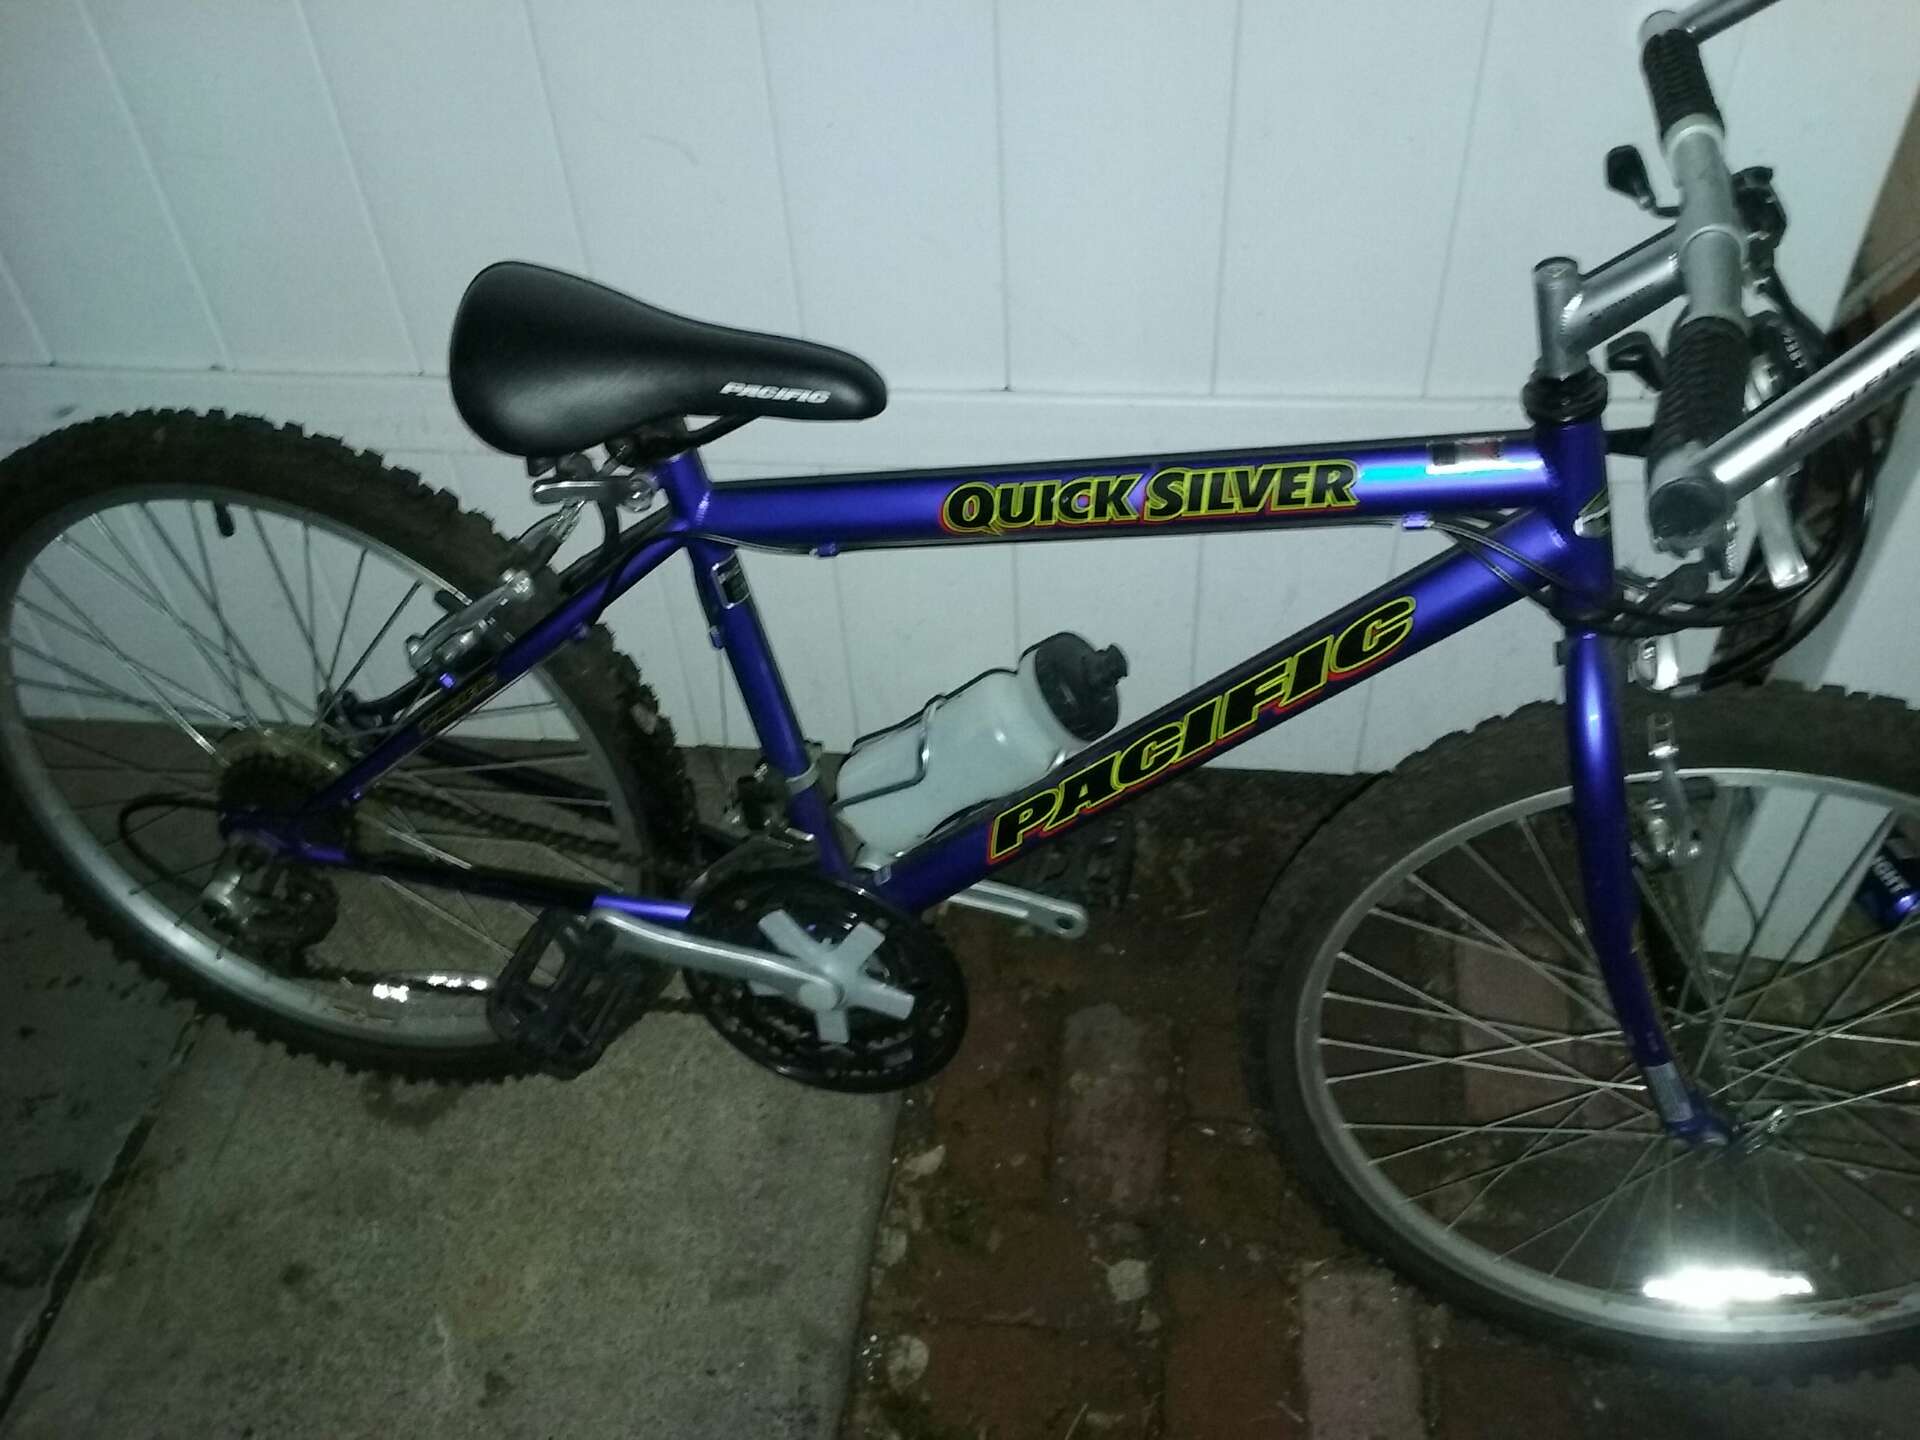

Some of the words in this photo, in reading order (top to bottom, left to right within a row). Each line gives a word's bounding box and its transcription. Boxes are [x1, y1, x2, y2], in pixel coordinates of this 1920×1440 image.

[720, 381, 832, 404] PACIFIC
[941, 474, 1143, 535] QUICK
[1142, 459, 1359, 522] SILVER
[988, 596, 1416, 863] PACIFIC
